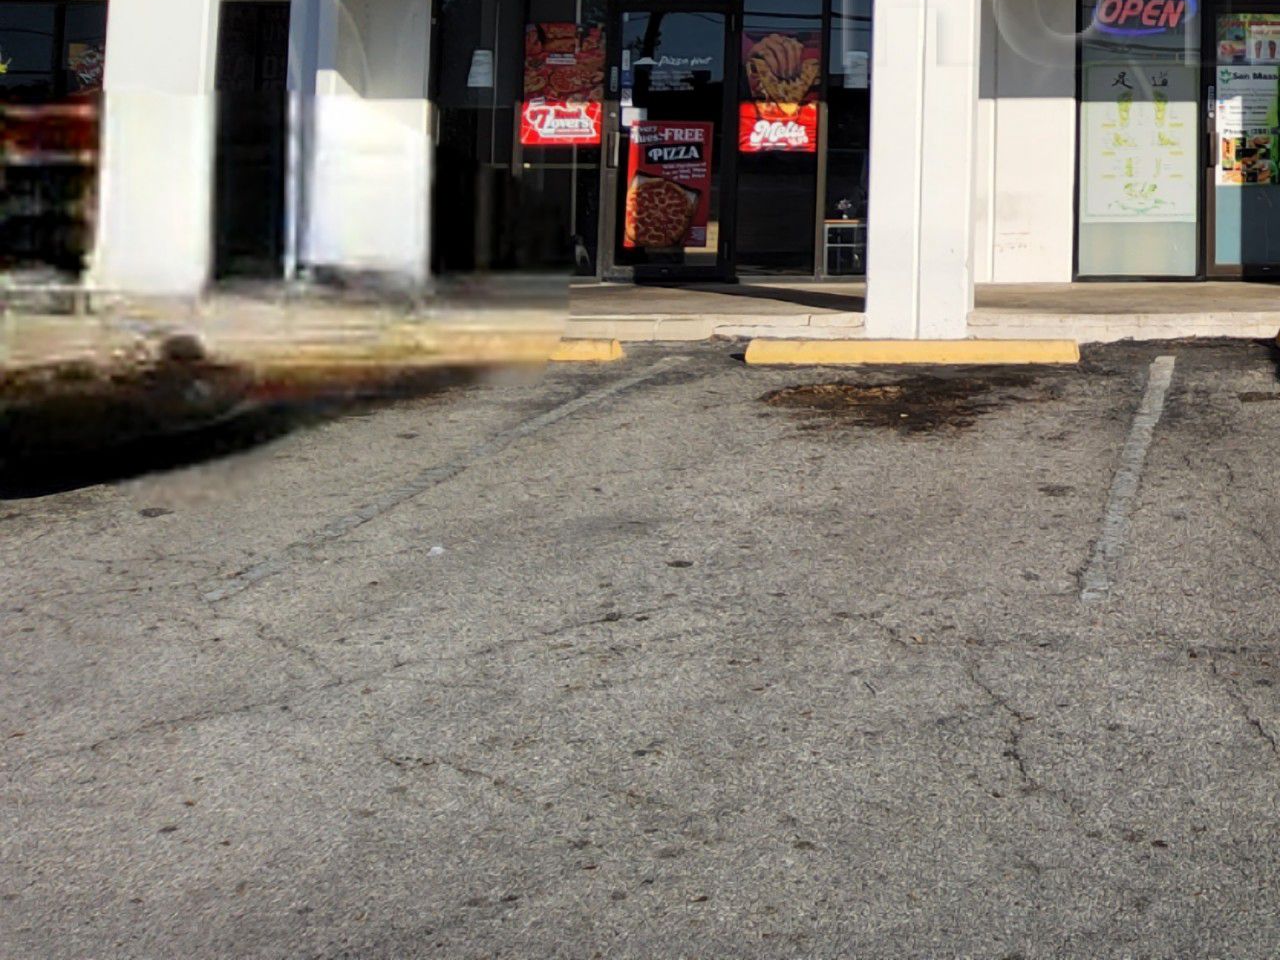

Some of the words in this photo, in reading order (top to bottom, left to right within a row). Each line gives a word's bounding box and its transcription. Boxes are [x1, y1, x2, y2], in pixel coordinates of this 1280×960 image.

[660, 127, 705, 142] FREE
[750, 119, 809, 146] Melts
[648, 145, 700, 161] PIZZA
